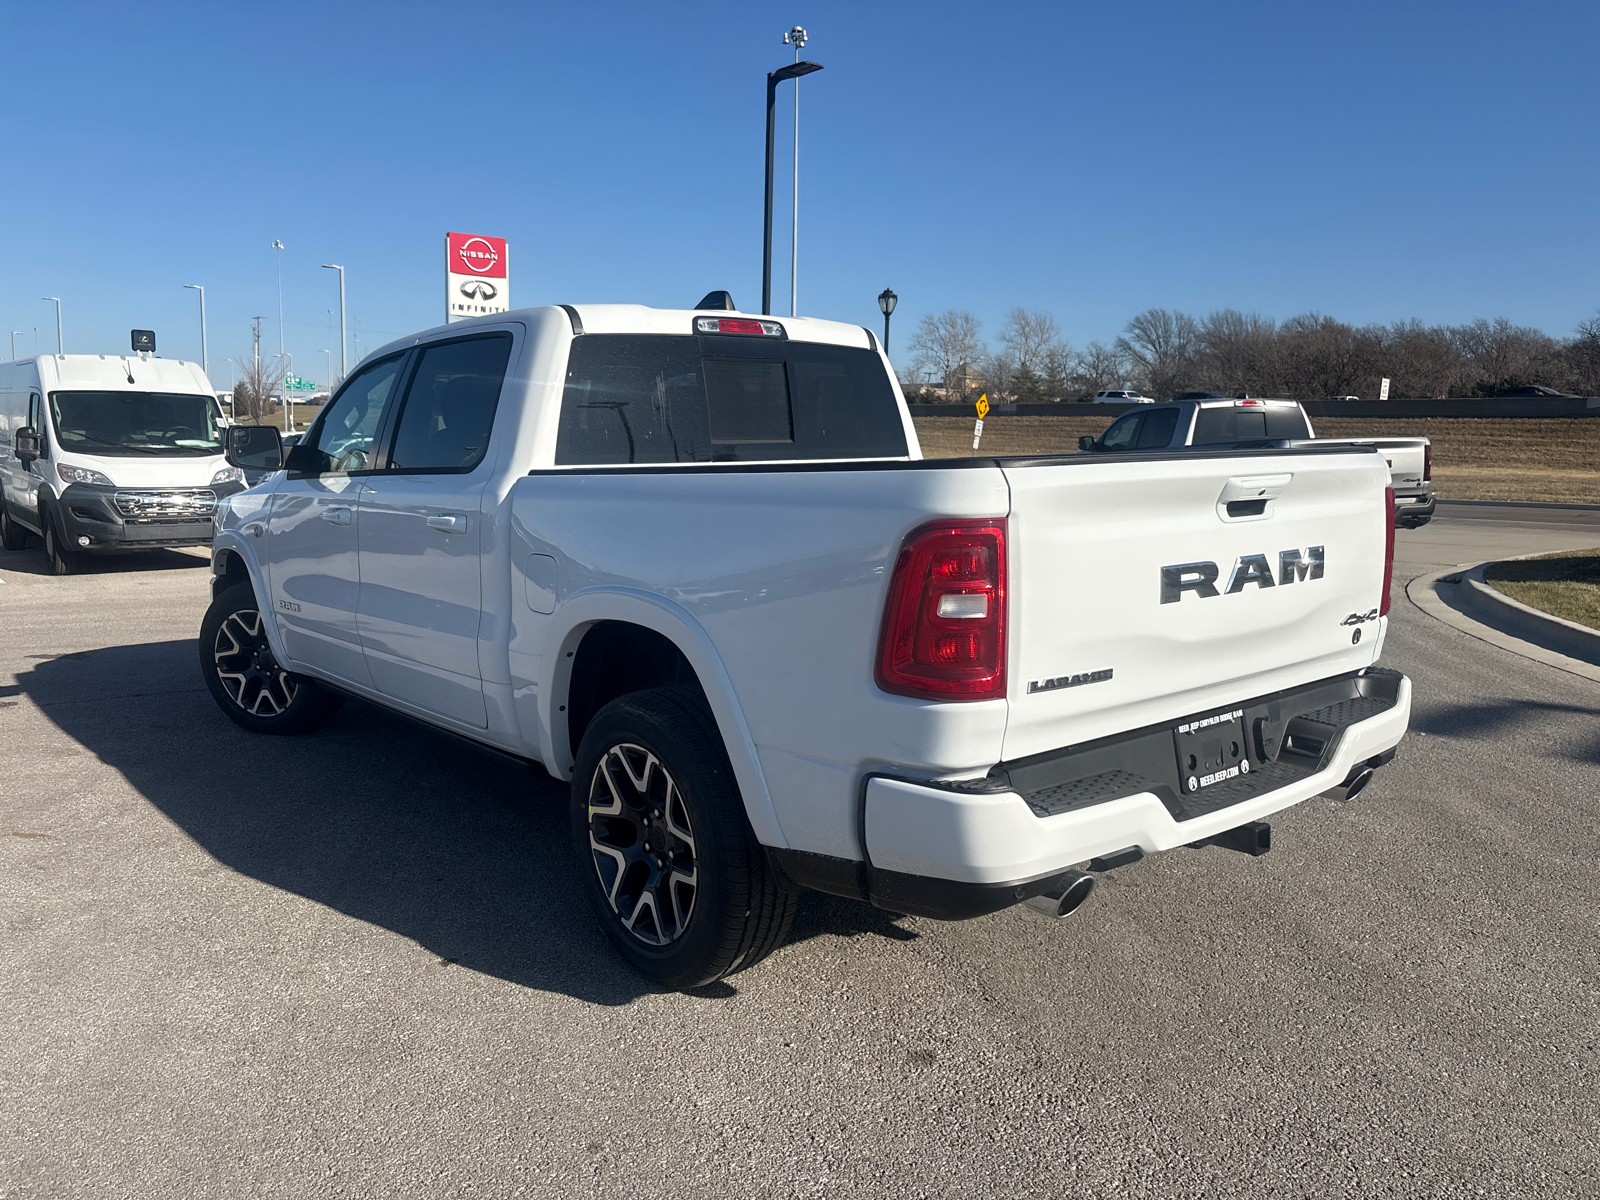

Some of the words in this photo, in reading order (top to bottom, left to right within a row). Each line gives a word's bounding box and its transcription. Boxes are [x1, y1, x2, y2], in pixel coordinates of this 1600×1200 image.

[459, 250, 498, 260] NISSAN
[1160, 545, 1325, 605] RAM
[279, 599, 301, 613] RAM
[1026, 667, 1114, 695] LARAMIE
[1178, 724, 1190, 734] REED
[1190, 721, 1200, 731] JEEP
[1199, 715, 1220, 728] CHRYSLER
[1219, 711, 1233, 722] DODGE
[1232, 709, 1243, 719] RAM
